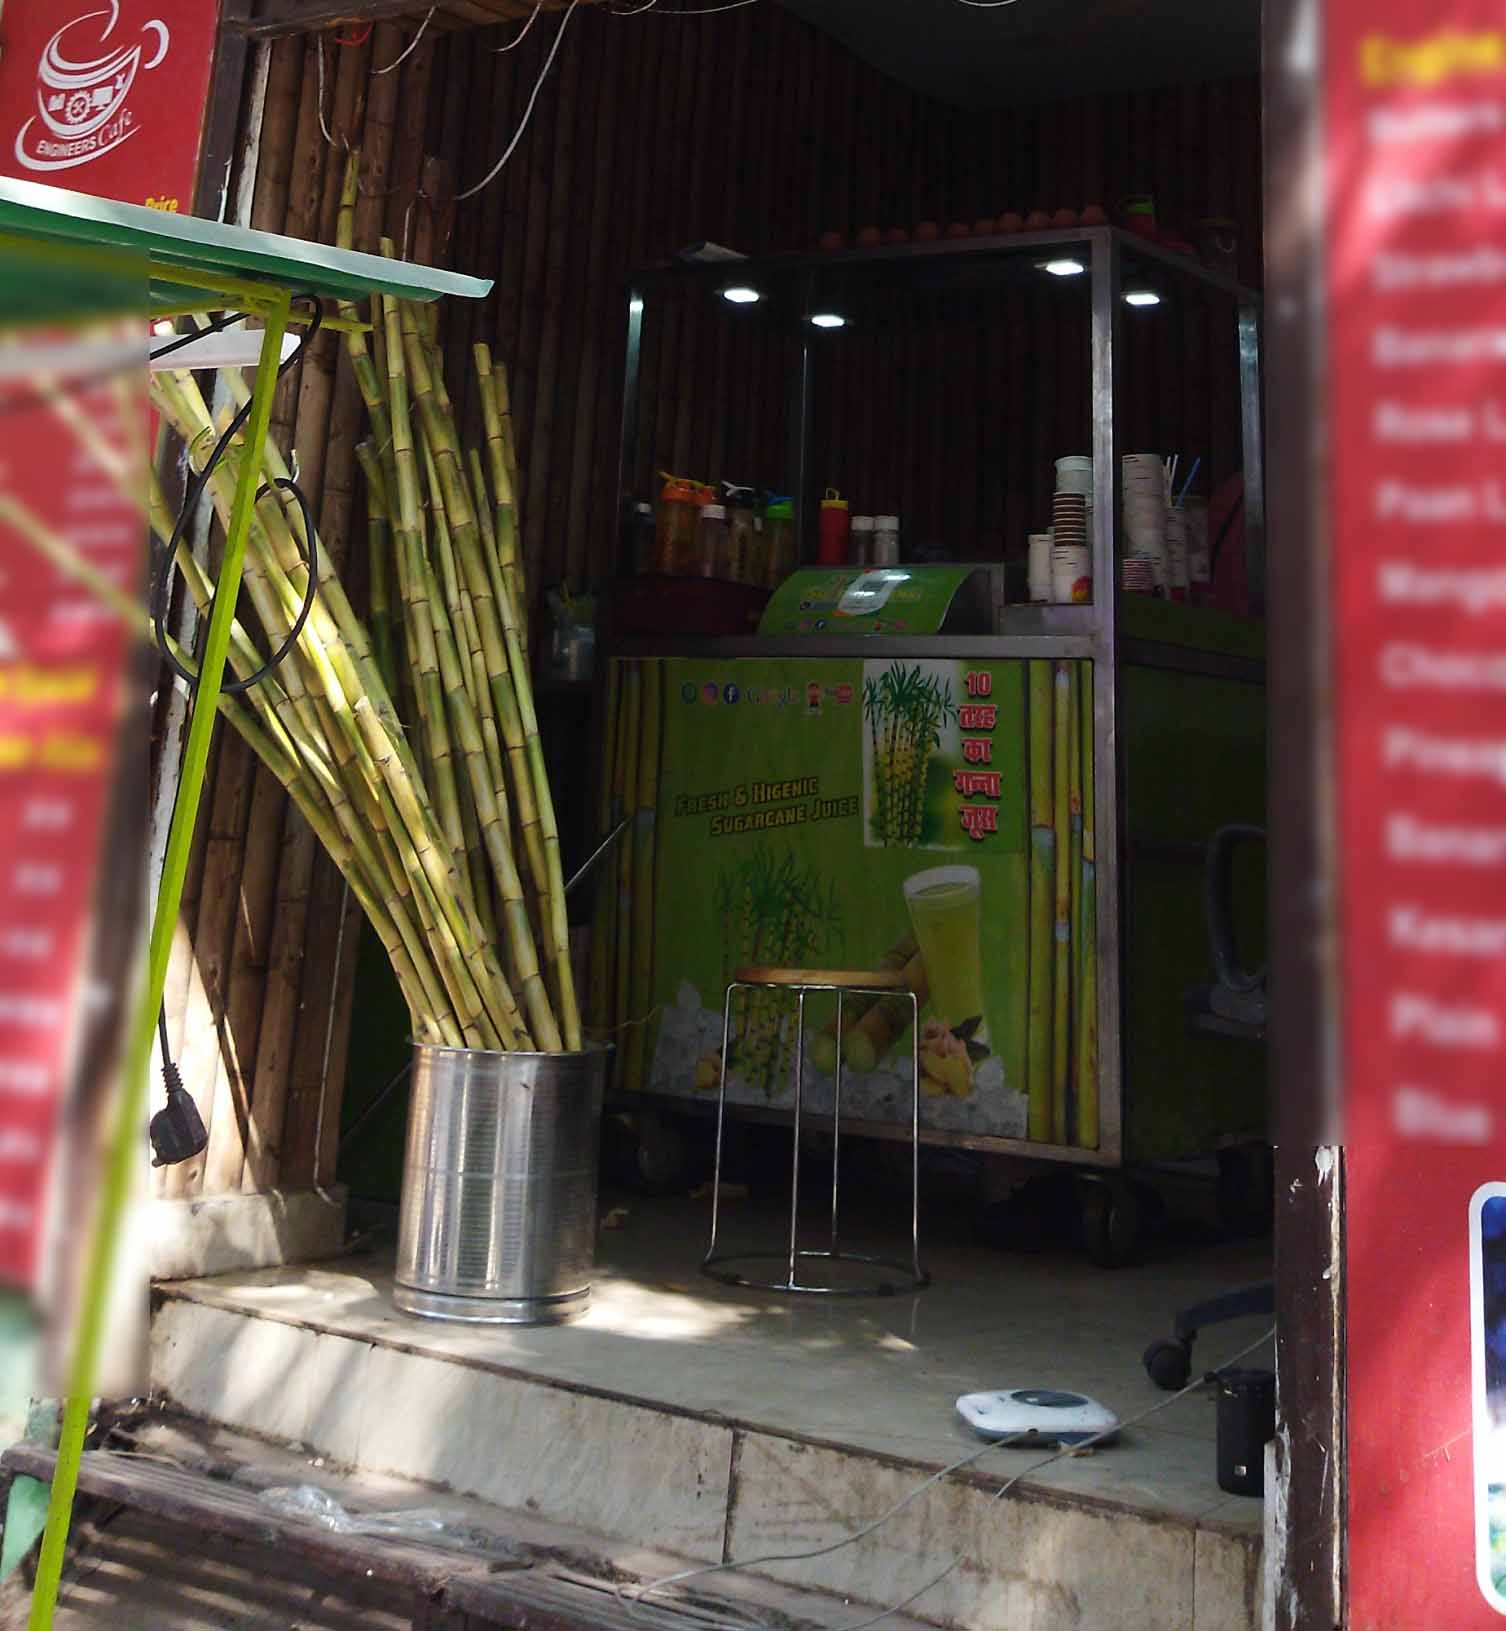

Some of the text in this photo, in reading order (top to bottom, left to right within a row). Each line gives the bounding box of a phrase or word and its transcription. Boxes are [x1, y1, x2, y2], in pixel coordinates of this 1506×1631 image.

[36, 136, 97, 157] ENGINEERS
[965, 671, 992, 697] 10
[958, 704, 998, 729] तरह
[961, 736, 993, 763] का
[711, 794, 860, 837] SUGARCANE JUICE
